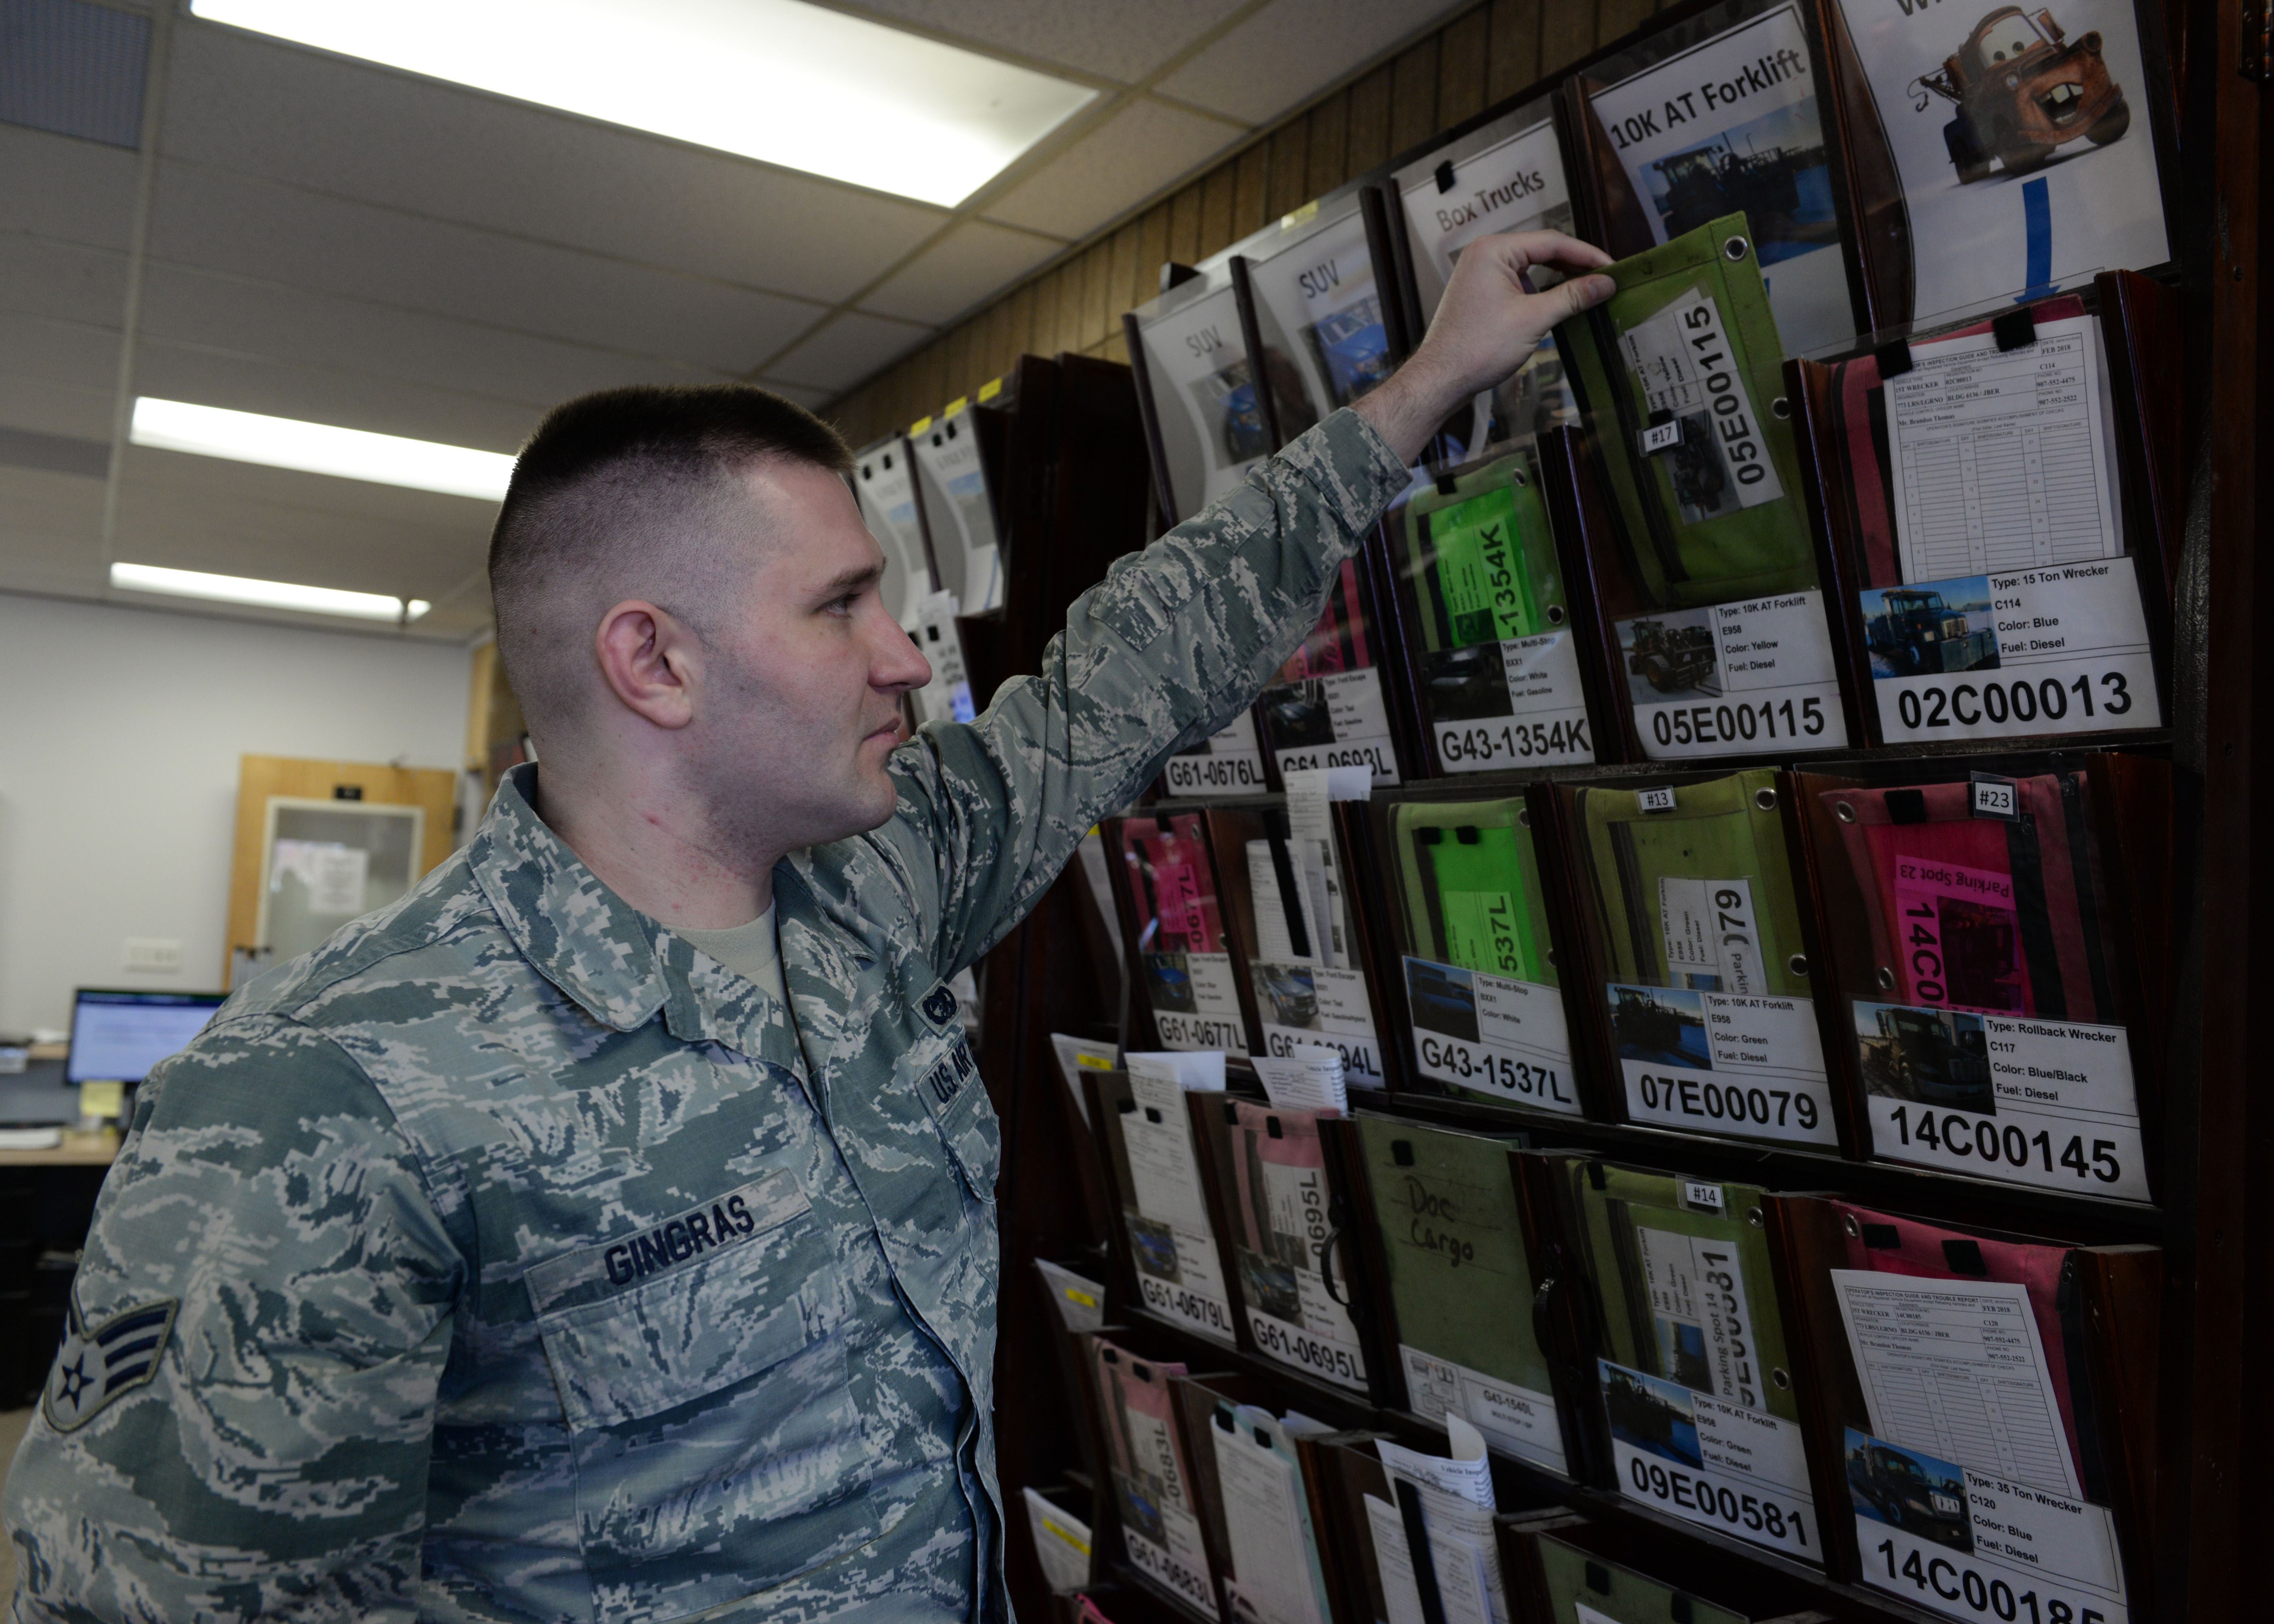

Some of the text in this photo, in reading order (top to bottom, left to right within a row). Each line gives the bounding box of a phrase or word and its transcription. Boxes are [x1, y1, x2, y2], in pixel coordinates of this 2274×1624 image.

[1610, 49, 1806, 149] 10K AT Forklift
[1436, 171, 1545, 232] Box Trucks
[1300, 260, 1340, 299] SUV
[1186, 326, 1223, 357] SUV
[1684, 306, 1764, 484] 05E00115
[1652, 427, 1672, 443] #17
[1992, 565, 2109, 590] Type: 15 Ton Wrecker
[1719, 596, 1806, 618] Type: 10K AT Forklift
[1995, 598, 2021, 611] C114
[1722, 626, 1742, 635] E958
[1998, 616, 2059, 632] Color: Blue
[1726, 640, 1779, 654] Color: Yellow
[2001, 638, 2064, 653] Fuel: Diesel
[1728, 659, 1775, 672] Fuel: Diesel
[1898, 672, 2132, 729] 02C00013
[1653, 697, 1825, 746] 05E00115
[1442, 719, 1591, 761] G43-1354K
[1170, 759, 1266, 788] G61-0676L
[1648, 792, 1668, 806] #13
[1980, 792, 2009, 808] #23
[1900, 865, 2009, 898] Parking Spot 23
[1906, 902, 1945, 1010] 14C0
[1708, 996, 1794, 1011] Type: 10K AT Forklift
[1159, 1015, 1247, 1050] G61-0677L
[1502, 1014, 1520, 1024] White
[1712, 1014, 1731, 1024] E958
[1987, 1020, 2117, 1043] Type: Rollback Wrecker
[1715, 1032, 1768, 1045] Color: Green
[1990, 1042, 2015, 1053] C117
[951, 1041, 973, 1083] AIR
[1421, 1037, 1571, 1104] G43-1537L
[1718, 1051, 1767, 1063] Fuel: Diesel
[1994, 1063, 2088, 1084] Color: Blue/Black
[1641, 1074, 1817, 1129] 07E00079
[1997, 1084, 2058, 1101] Fuel: Diesel
[1891, 1106, 2120, 1182] 14C00145
[1694, 1187, 1716, 1203] #14
[604, 1194, 756, 1286] GINGRAS
[1411, 1217, 1474, 1268] Cargo
[1143, 1278, 1232, 1333] G61-0679L
[1710, 1313, 1722, 1343] Spot
[1253, 1318, 1368, 1382] G61-0695L
[1715, 1347, 1734, 1396] Parking
[1694, 1396, 1778, 1431] Type: 10K AT Forklift
[1697, 1415, 1716, 1428] E958
[1700, 1432, 1752, 1456] Color: Green
[1703, 1450, 1752, 1472] Fuel: Diesel
[1632, 1457, 1807, 1546] 09E00581
[1966, 1472, 2082, 1514] Type: 35 Ton Wrecker
[1971, 1495, 1996, 1510] C120
[1973, 1515, 2033, 1542] Color: Blue
[1977, 1535, 2038, 1564] Fuel: Diesel
